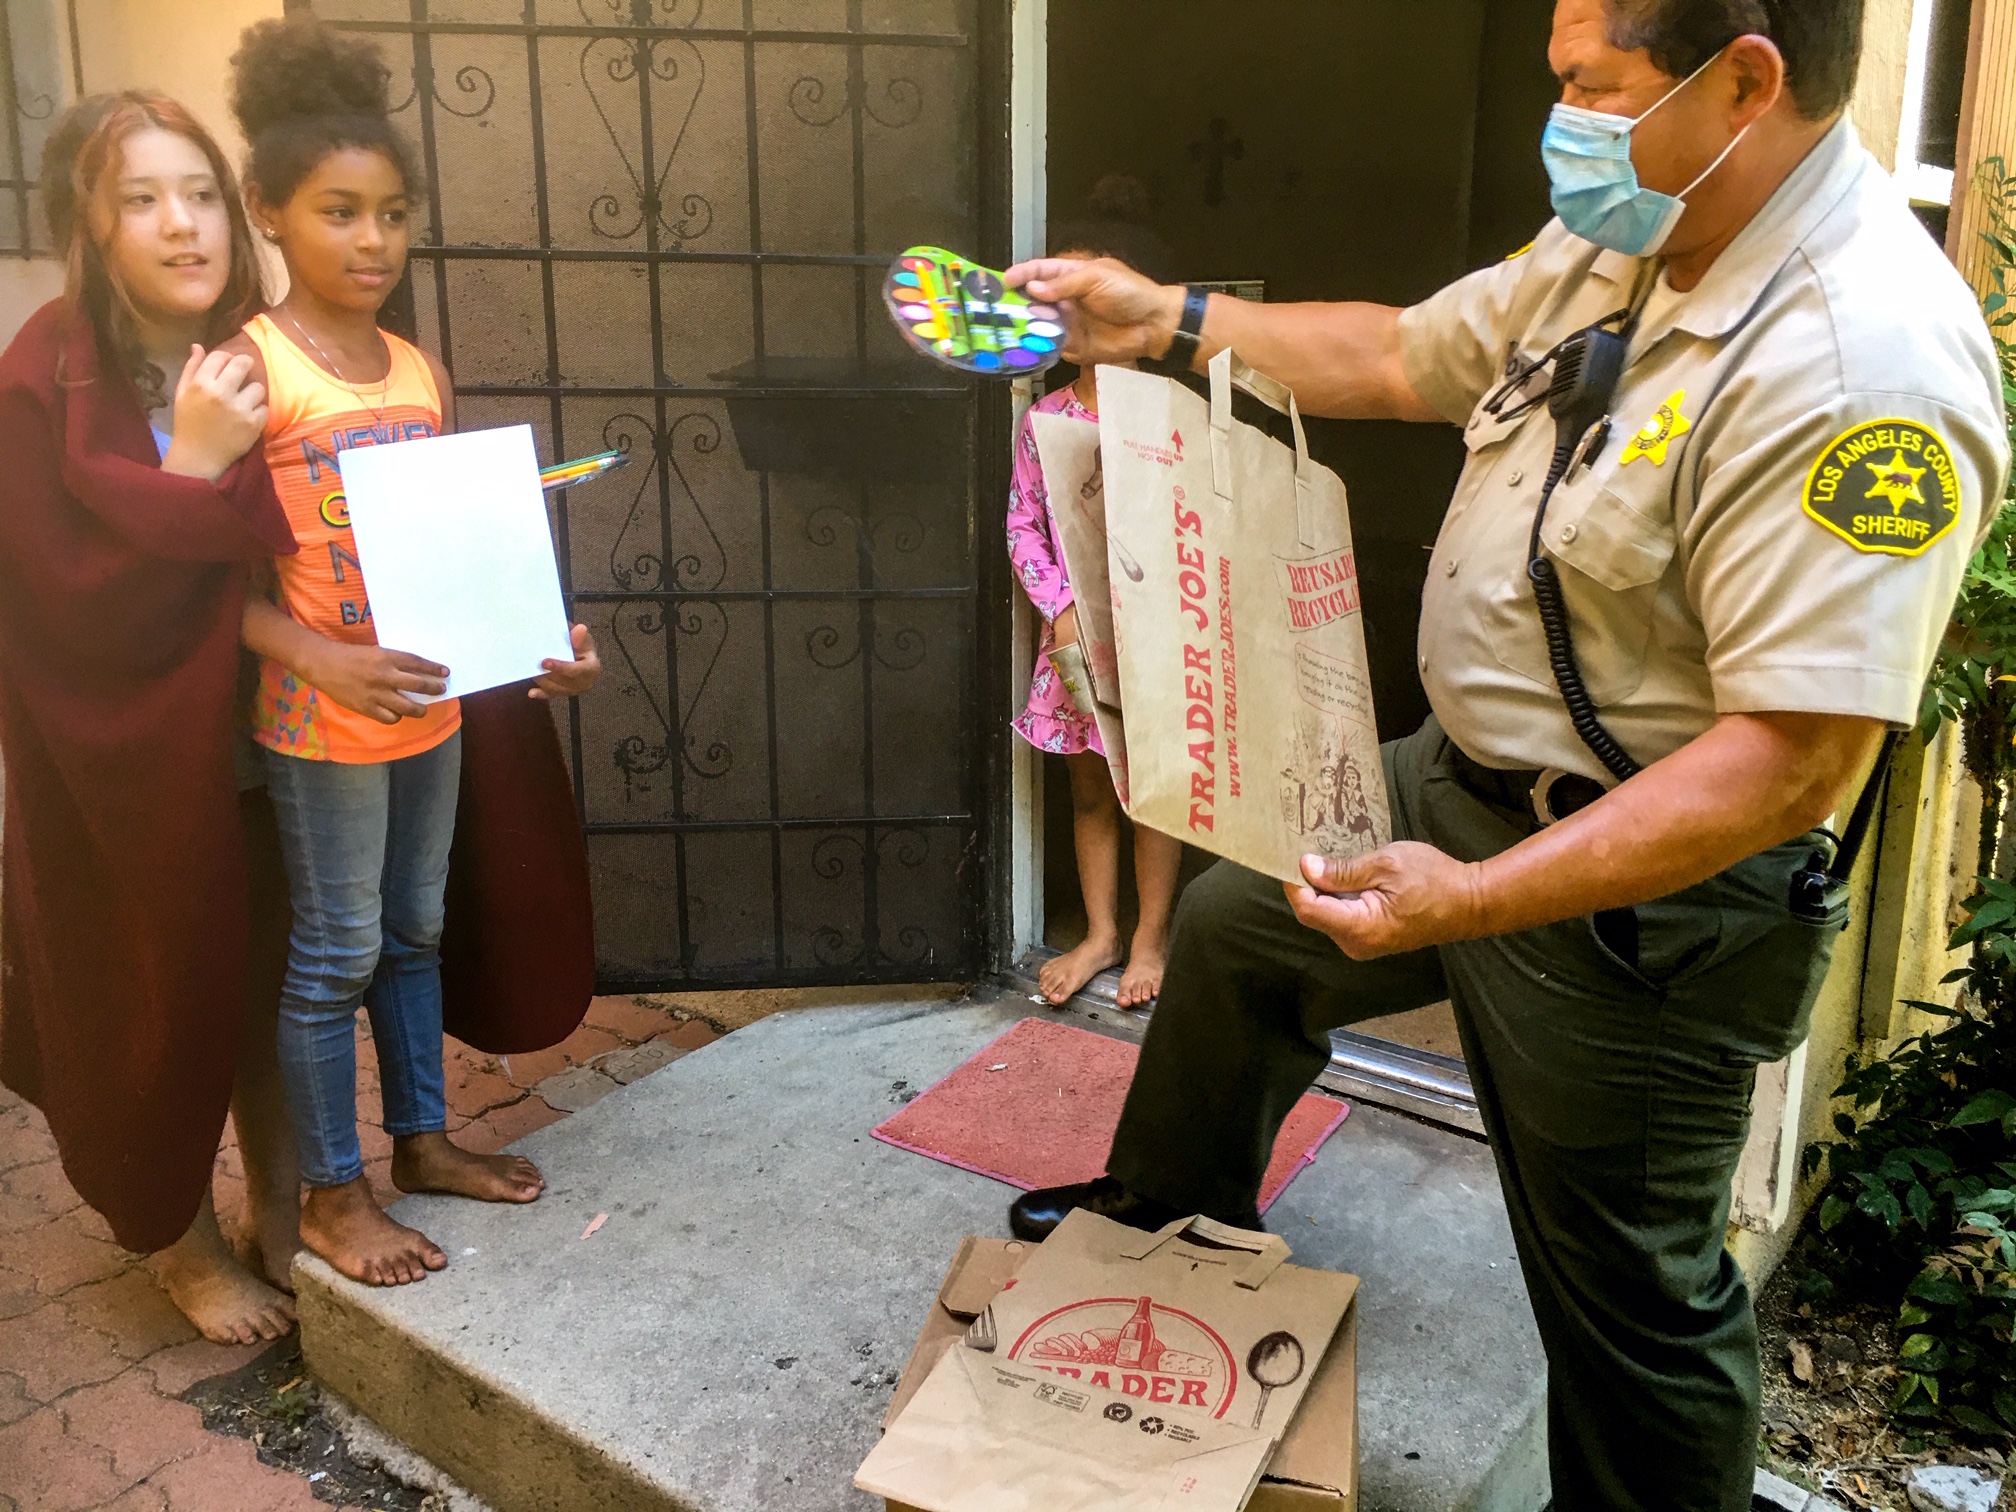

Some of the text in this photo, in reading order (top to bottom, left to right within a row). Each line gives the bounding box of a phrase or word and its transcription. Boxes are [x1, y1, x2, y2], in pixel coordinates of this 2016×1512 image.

[1156, 456, 1173, 467] OUT
[1173, 453, 1184, 462] UP
[1813, 429, 1957, 513] LOS ANGELES COUNTY
[1852, 515, 1931, 540] SHERIFF
[1175, 499, 1215, 833] TRADER JOE'S
[1033, 1365, 1208, 1406] ADER
